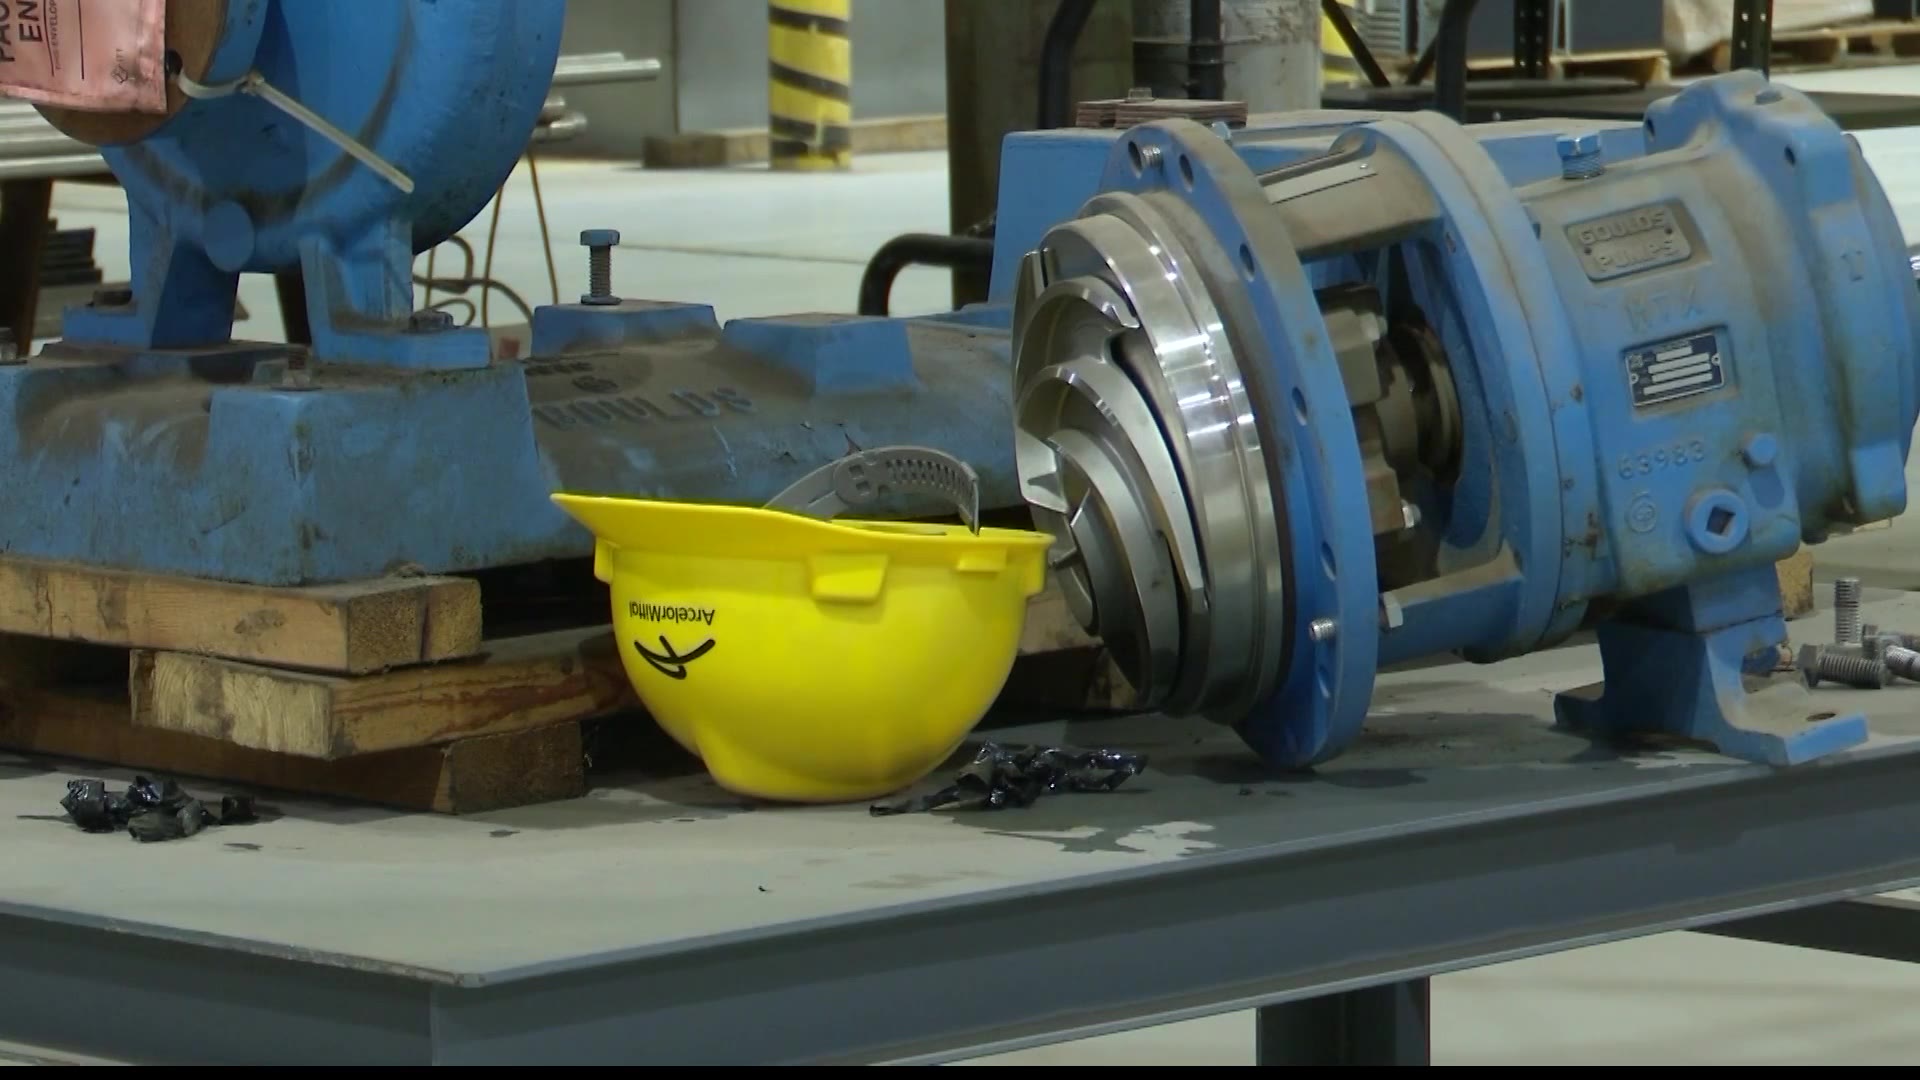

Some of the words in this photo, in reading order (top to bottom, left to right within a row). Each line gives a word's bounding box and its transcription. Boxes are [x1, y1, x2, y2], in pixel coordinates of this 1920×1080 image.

[1579, 210, 1667, 245] GOULDS
[1595, 238, 1679, 273] PUMPS
[1618, 440, 1704, 480] 63983
[629, 601, 716, 626] ArcelorMittal
